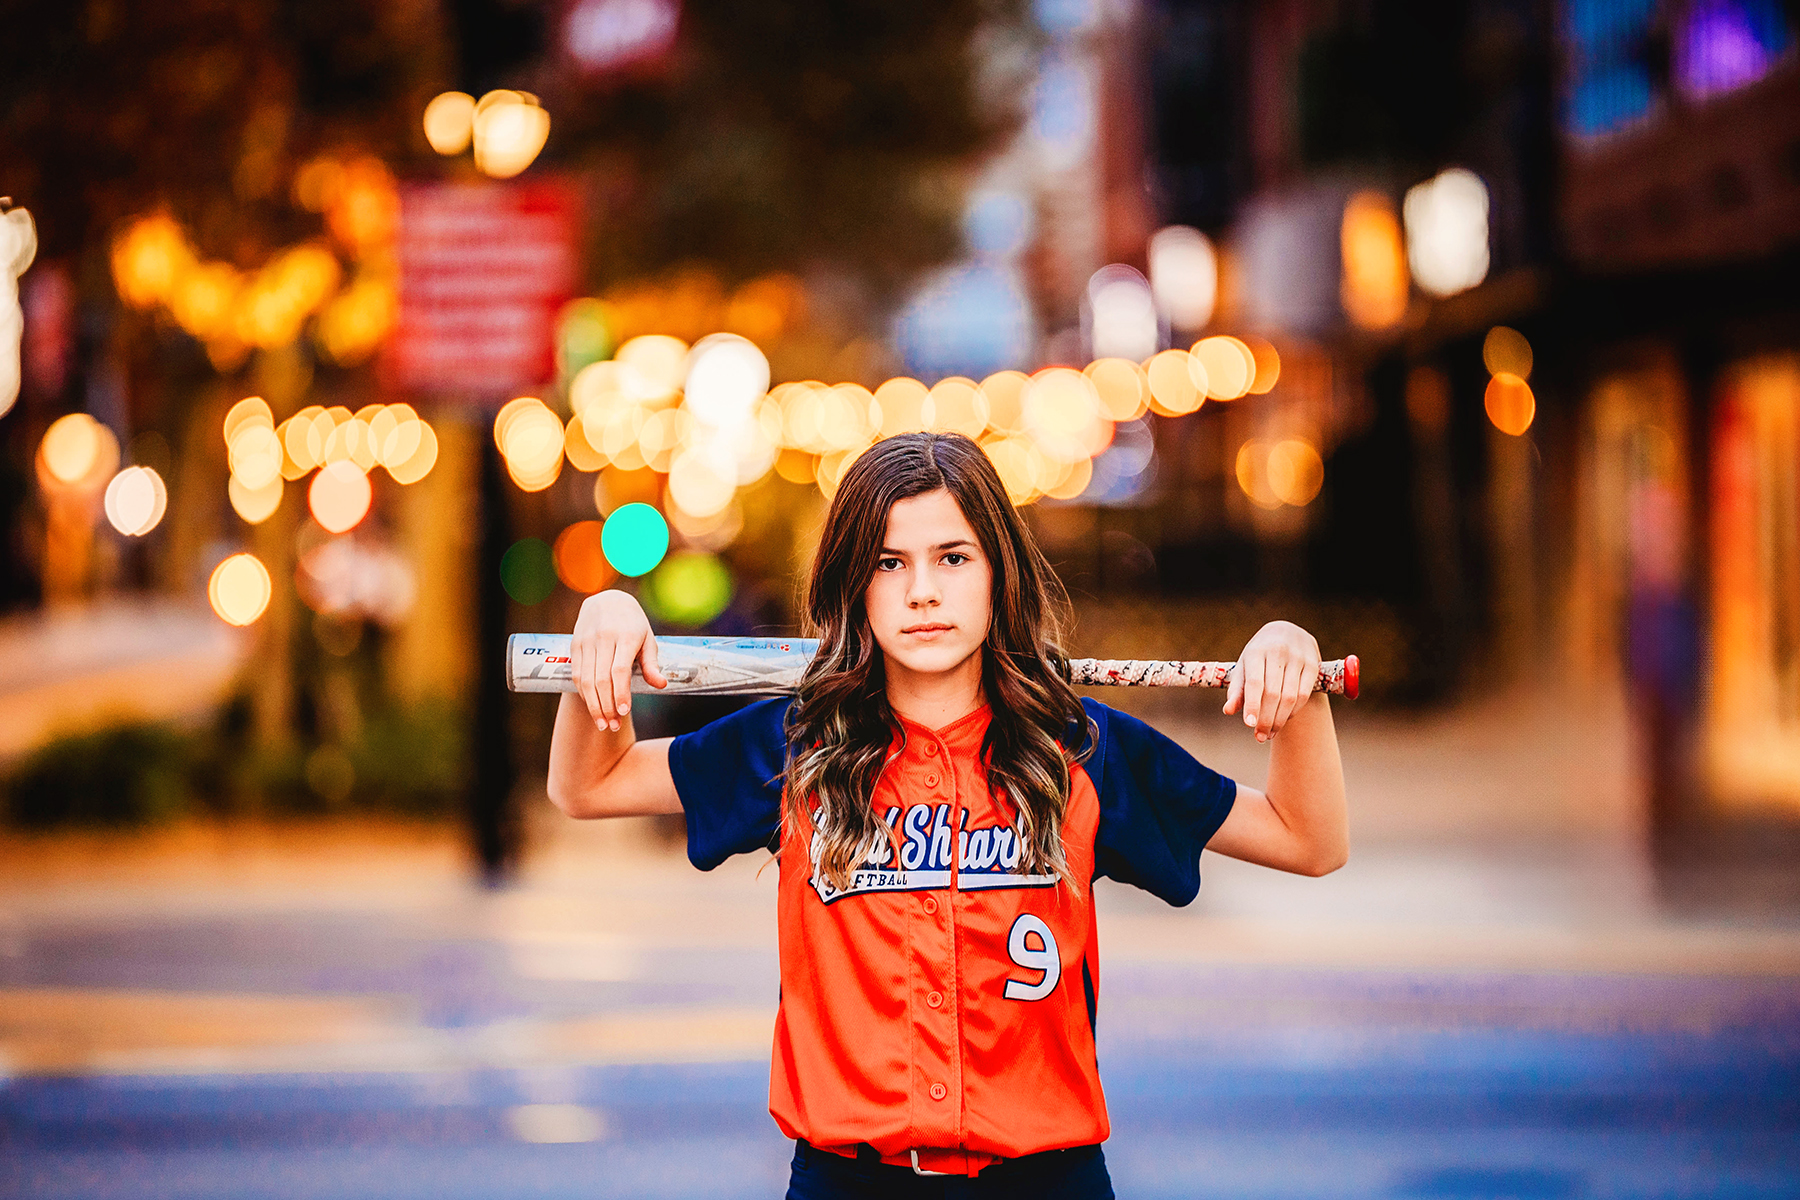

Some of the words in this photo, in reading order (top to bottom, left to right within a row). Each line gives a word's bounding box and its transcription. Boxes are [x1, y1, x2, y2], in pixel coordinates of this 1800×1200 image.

[901, 803, 1066, 870] Shark
[823, 872, 908, 896] SFTBALL
[1002, 913, 1061, 1002] 9
